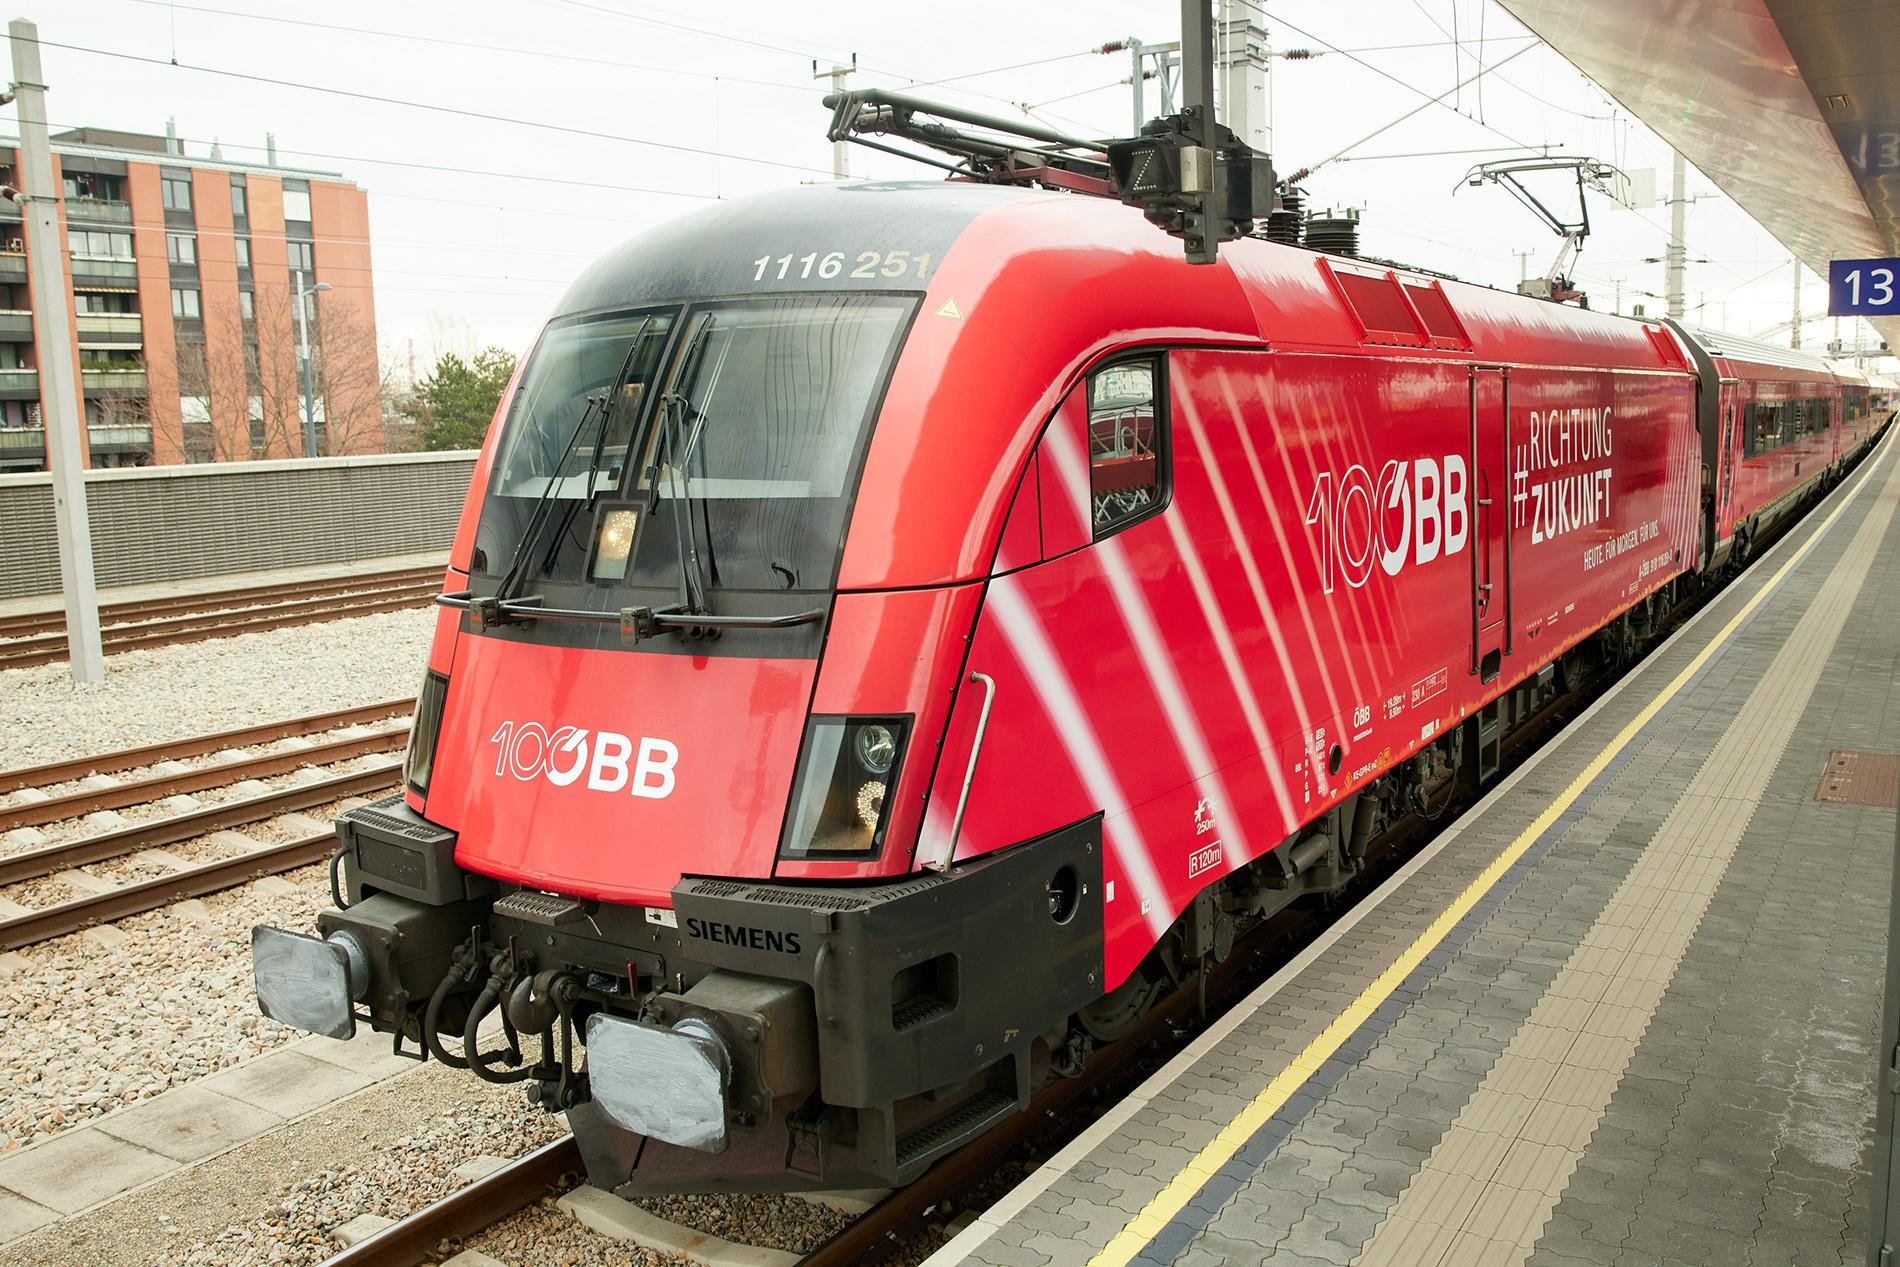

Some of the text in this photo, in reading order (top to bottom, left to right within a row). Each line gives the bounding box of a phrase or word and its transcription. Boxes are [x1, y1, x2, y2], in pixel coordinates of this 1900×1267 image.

[753, 250, 930, 281] 1116 251
[1843, 267, 1894, 306] 13
[1531, 468, 1612, 545] ZUKUNFT
[1583, 544, 1604, 571] HEUTE.
[1605, 536, 1616, 561] FÜR
[1640, 521, 1649, 542] FÜR
[1353, 705, 1370, 728] ÖBB
[1196, 818, 1216, 835] 250m
[1191, 848, 1220, 873] R 120m
[686, 917, 801, 955] SIEMENS
